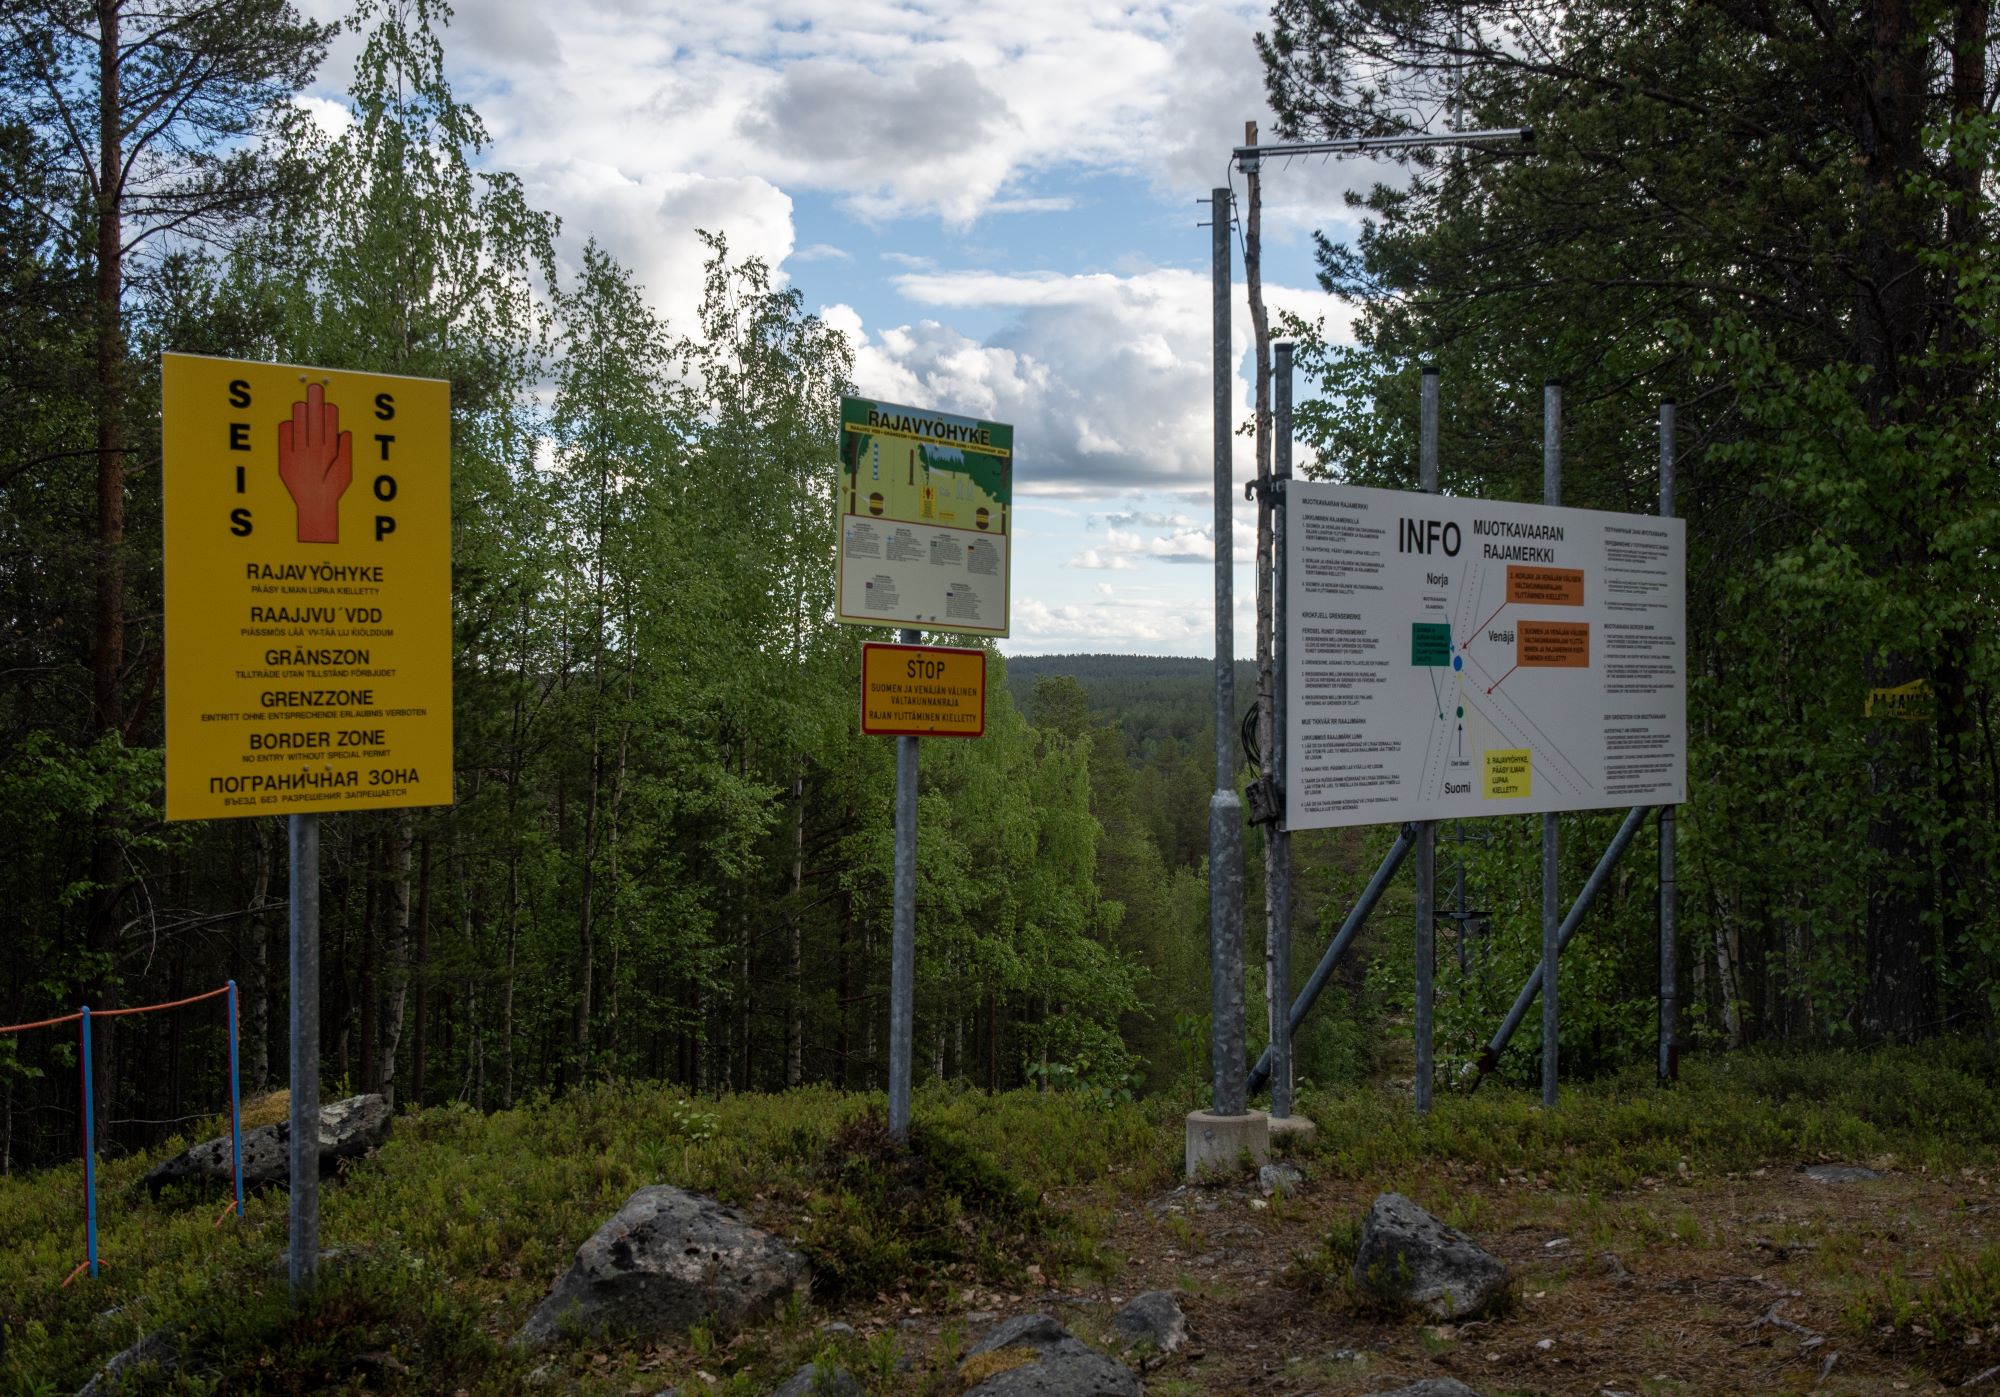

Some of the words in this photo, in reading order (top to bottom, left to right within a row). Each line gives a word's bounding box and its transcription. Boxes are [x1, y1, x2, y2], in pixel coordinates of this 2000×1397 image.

[868, 410, 991, 447] RAJAVYÖHYKE
[228, 379, 253, 537] SEIS
[373, 393, 398, 542] STOP
[1399, 517, 1462, 558] INFO
[1473, 519, 1564, 542] MUOTKAVAARAN
[1483, 543, 1554, 564] RAJAMERKKI
[247, 561, 384, 583] RAJAVYÖHYKE
[1426, 572, 1448, 588] Norja
[251, 585, 279, 595] PÄÄSY
[281, 586, 307, 595] ILMAN
[308, 587, 335, 596] LUPAA
[337, 587, 380, 596] KIELLETTY
[1488, 630, 1514, 645] Venäjä
[265, 645, 370, 666] GRÄNSZON
[235, 669, 280, 679] TILLTRÄDE
[282, 669, 304, 679] UTAN
[907, 659, 945, 680] STOP
[871, 682, 902, 694] SUOMEN
[904, 684, 913, 694] JA
[260, 690, 374, 708] GRENZZONE
[201, 713, 240, 722] EINTRITT
[242, 712, 266, 721] OHNE
[268, 711, 338, 721] ENTSPRECHENDE
[340, 709, 383, 719] ERLAUBNIS
[384, 708, 427, 718] VERBOTEN
[869, 710, 892, 721] RAJAN
[250, 732, 330, 750] BORDER
[337, 730, 386, 746] ZONE
[242, 754, 255, 764] NO
[257, 753, 284, 763] ENTRY
[287, 752, 326, 762] WITHOUT
[327, 750, 361, 760] SPECIAL
[363, 749, 391, 759] PERMIT
[210, 771, 358, 794] ПОГРАНИЧНАЯ
[368, 768, 420, 786] ЗОНА
[1444, 781, 1471, 794] Suomi
[224, 796, 257, 807] ВЪЕЗД
[260, 795, 278, 805] БЕЗ
[282, 791, 342, 803] РАЗРЕШЕНИЯ
[344, 788, 407, 800] ЗАПРЕЩАЕТСЯ
